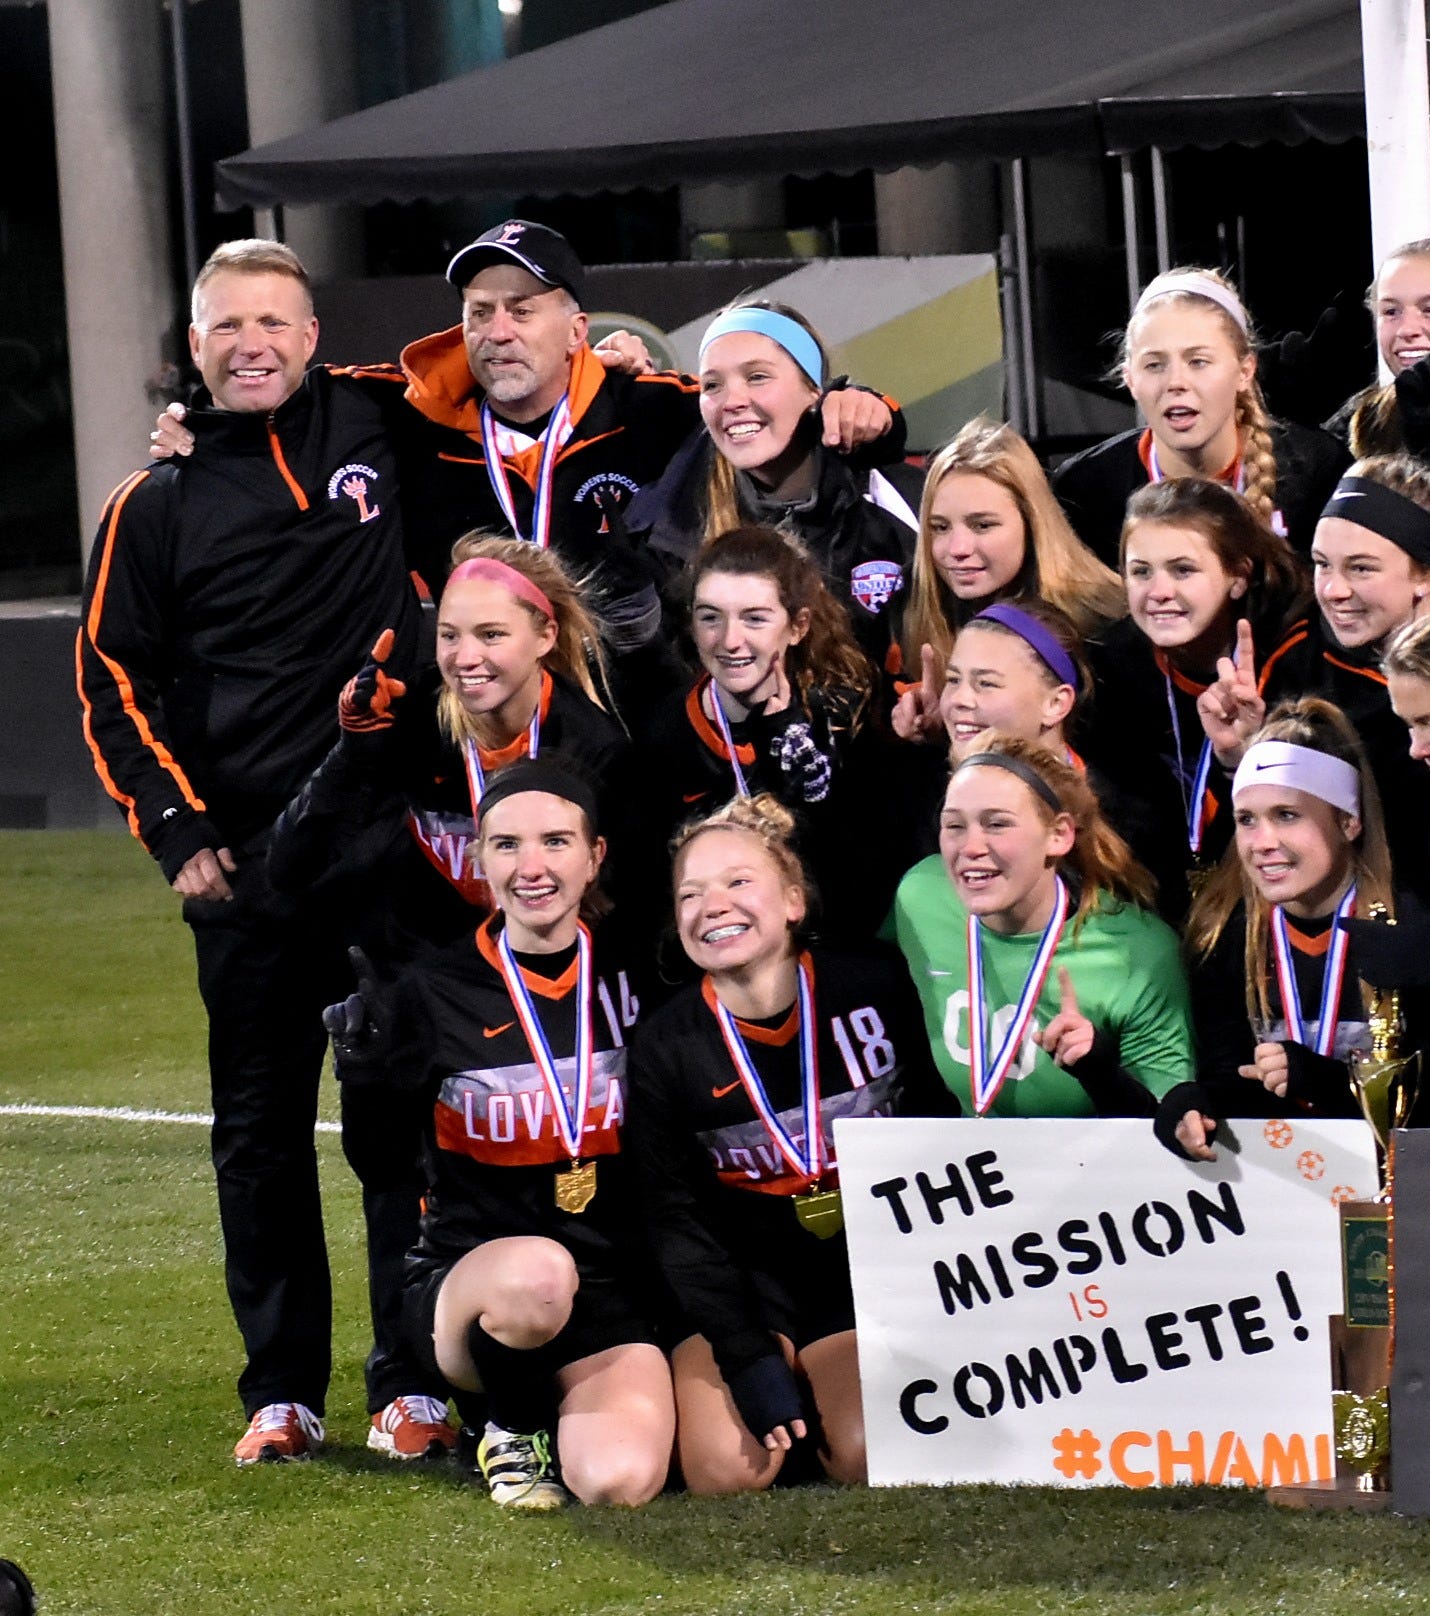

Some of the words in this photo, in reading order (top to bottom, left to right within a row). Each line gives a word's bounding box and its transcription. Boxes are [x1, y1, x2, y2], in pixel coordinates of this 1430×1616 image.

[831, 1006, 896, 1089] 18
[871, 1150, 1015, 1235] THE
[933, 1181, 1245, 1315] MISSION
[1070, 1284, 1109, 1321] IS
[899, 1270, 1309, 1435] COMPLETE!
